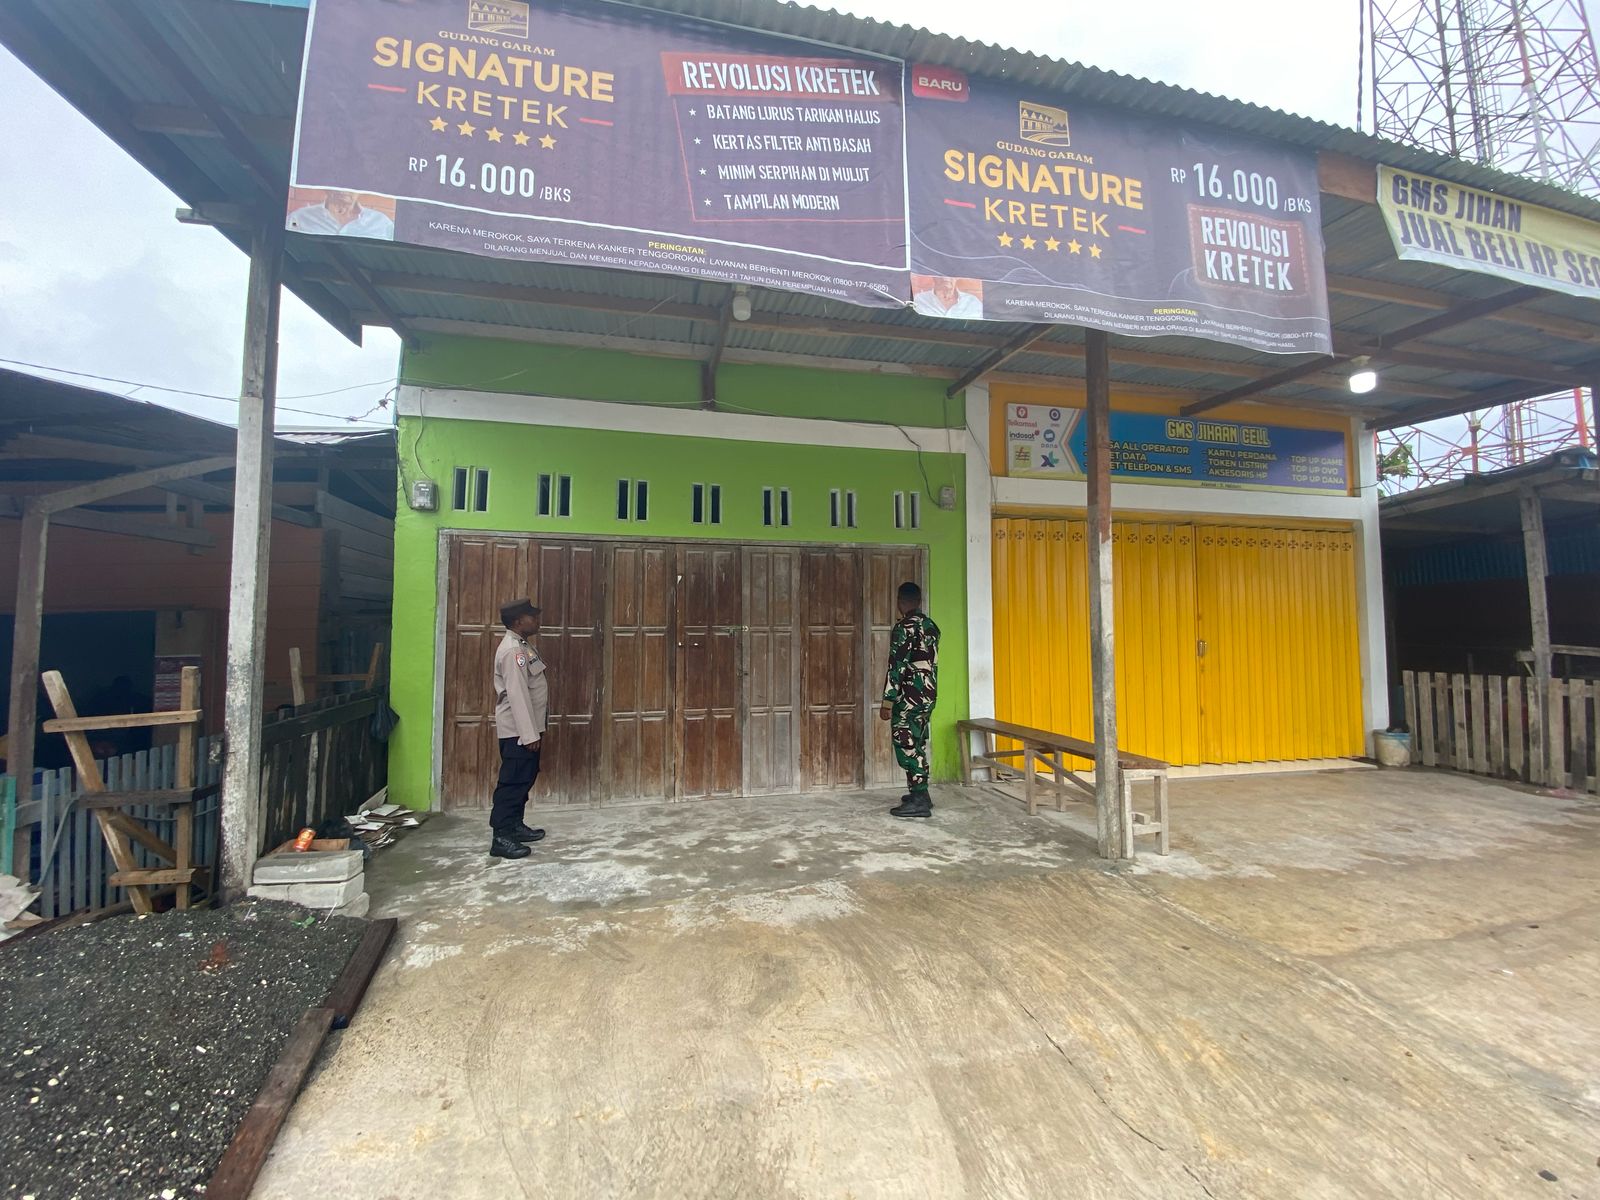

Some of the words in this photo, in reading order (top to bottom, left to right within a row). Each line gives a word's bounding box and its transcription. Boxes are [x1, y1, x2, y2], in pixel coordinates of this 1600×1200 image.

[438, 30, 500, 48] GUDANG
[502, 40, 556, 57] GARAM
[372, 36, 614, 103] SIGNATURE
[682, 61, 792, 92] REVOLUSI
[795, 66, 880, 96] KRETEK
[918, 76, 962, 92] BARU
[417, 81, 569, 129] KRETEK
[707, 104, 756, 120] BATANG
[758, 106, 794, 122] LURUS
[796, 107, 844, 123] TARIKAN
[845, 110, 880, 124] HALUS
[713, 134, 762, 150] KERTAS
[764, 135, 803, 151] FILTER
[806, 136, 832, 152] ANTI
[834, 137, 872, 152] BASAH
[996, 140, 1046, 158] GUDANG
[1048, 150, 1094, 164] GARAM
[408, 157, 428, 173] RP
[436, 154, 535, 198] 16.000
[539, 186, 572, 203] /BKS
[718, 164, 756, 180] MINIM
[758, 165, 817, 180] SERPIHAN
[818, 166, 830, 181] DI
[832, 167, 870, 182] MULUT
[944, 149, 1144, 210] SIGNATURE
[1170, 168, 1186, 184] RP
[1193, 162, 1278, 210] 16.000
[1284, 198, 1312, 214] /BKS
[724, 194, 790, 210] TAMPILAN
[792, 194, 840, 210] MODERN
[1392, 174, 1449, 216] GMS
[1454, 190, 1522, 234] JIHAN
[984, 196, 1110, 238] KRETEK
[648, 241, 706, 256] PERINGATAN:
[1200, 216, 1289, 258] REVOLUSI
[1396, 210, 1465, 257] JUAL
[1464, 226, 1525, 270] BELI
[1524, 239, 1559, 278] HP
[429, 221, 472, 236] KARENA
[527, 235, 551, 244] SAYA
[552, 237, 597, 250] TERKENA
[598, 244, 635, 255] KANKER
[710, 258, 748, 270] LAYANAN
[750, 264, 790, 277] BERHENTI
[792, 270, 832, 283] MEROKOK
[484, 242, 528, 254] DILARANG
[529, 246, 568, 258] MENJUAL
[570, 252, 588, 260] DAN
[588, 254, 627, 265] MEMBERI
[628, 259, 660, 270] KEPADA
[661, 264, 690, 274] ORANG
[691, 266, 700, 275] DI
[700, 268, 728, 278] BAWAH
[740, 273, 764, 284] TAHUN
[765, 277, 782, 286] DAN
[782, 280, 826, 293] PEREMPUAN
[826, 287, 848, 296] HAMIL
[1204, 249, 1294, 291] KRETEK
[1006, 299, 1035, 307] KARENA
[1073, 304, 1090, 312] SAYA
[1118, 313, 1145, 322] KANKER
[1167, 420, 1193, 439] GMS
[1242, 428, 1270, 446] CELL
[1122, 442, 1140, 451] ALL
[1141, 444, 1190, 454] OPERATOR
[1122, 452, 1147, 461] DATA
[1208, 448, 1236, 458] KARTU
[1238, 450, 1277, 460] PERDANA
[1123, 462, 1164, 472] TELEPON
[1173, 466, 1192, 474] SMS
[1208, 458, 1236, 467] TOKEN
[1291, 456, 1307, 464] TOP
[1291, 464, 1307, 472] TOP
[1208, 468, 1254, 478] AKSESORIS
[1292, 474, 1308, 482] TOP
